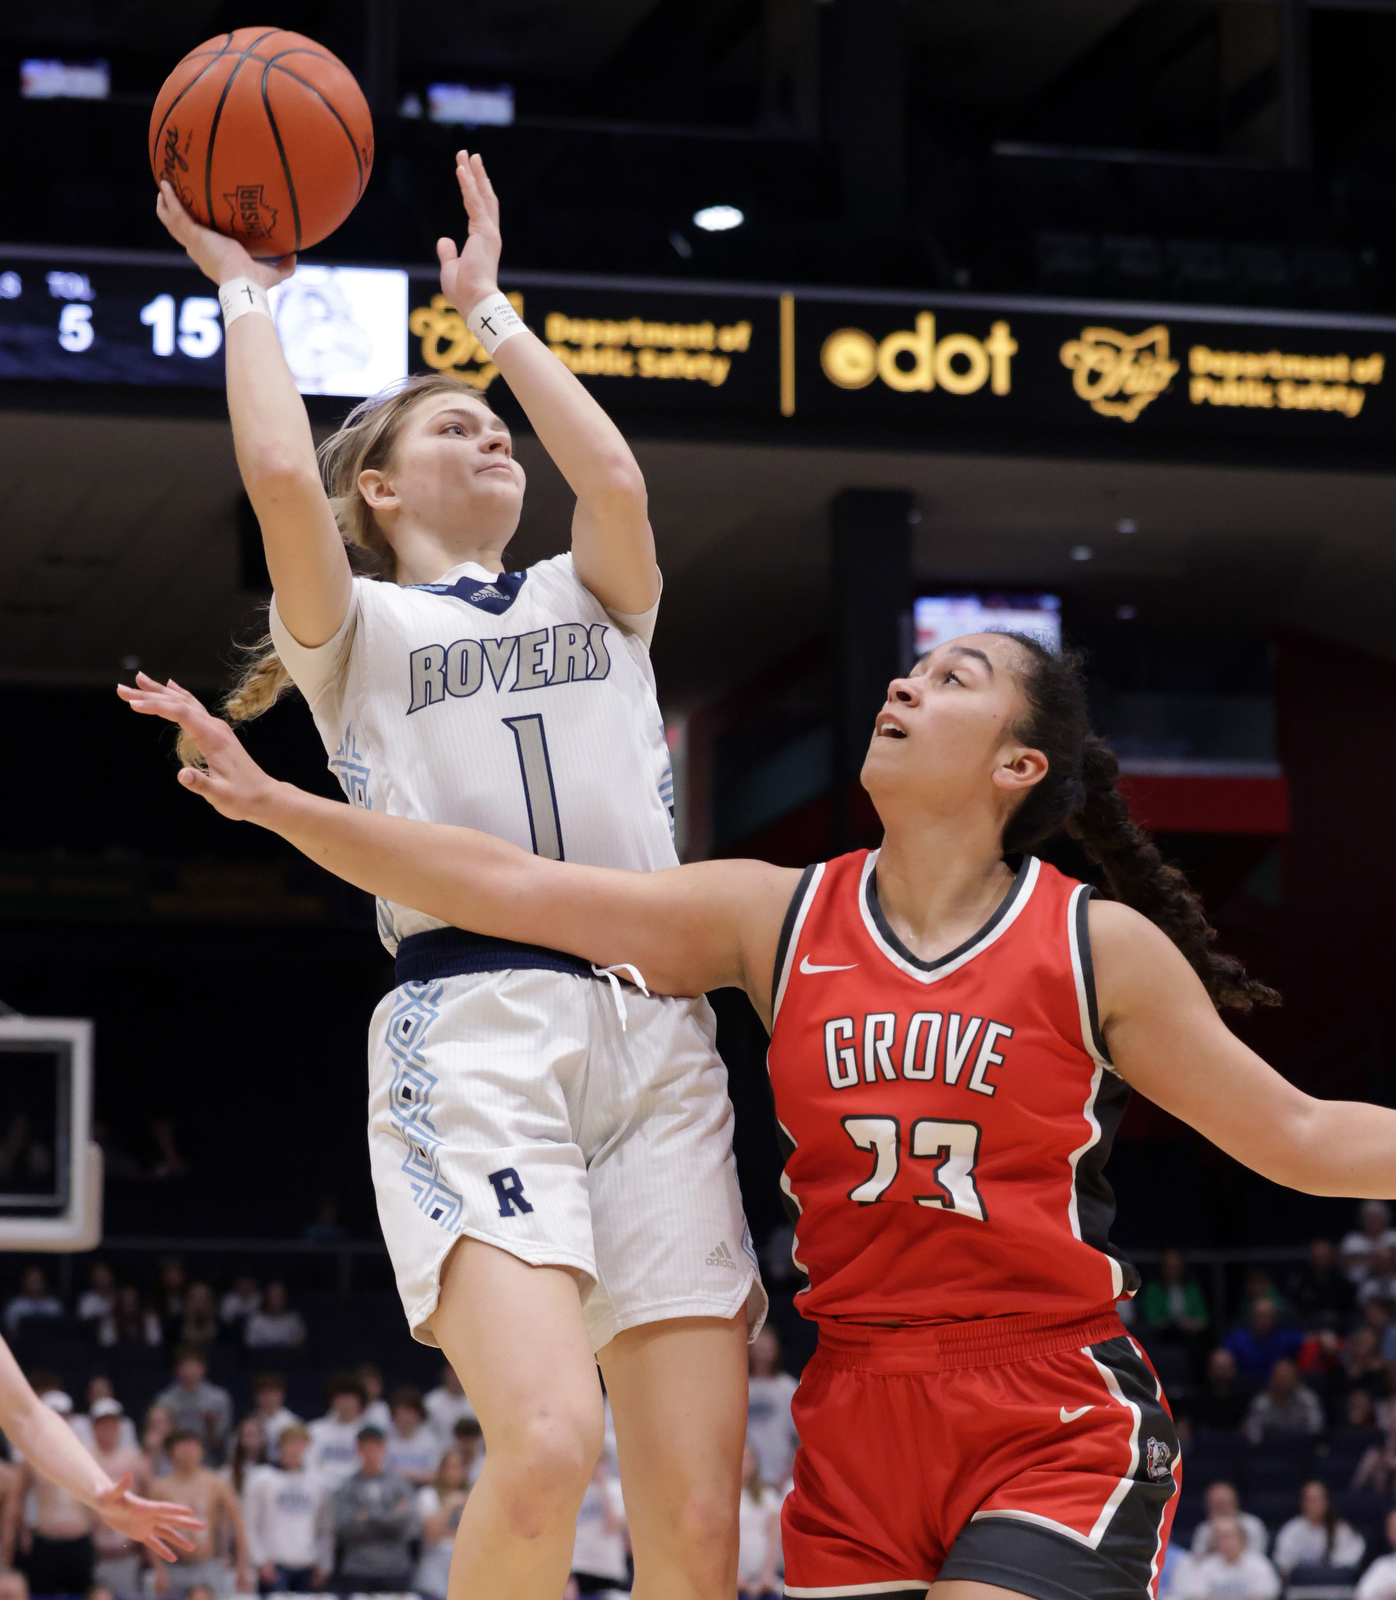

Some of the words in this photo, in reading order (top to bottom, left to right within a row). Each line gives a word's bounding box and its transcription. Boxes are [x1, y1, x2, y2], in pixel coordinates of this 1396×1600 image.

[59, 304, 94, 352] 5
[140, 293, 222, 358] 15
[545, 311, 715, 350] Department
[717, 321, 752, 353] of
[636, 348, 731, 387] Safety
[1189, 345, 1350, 383] Department
[1351, 353, 1385, 385] of
[1189, 376, 1274, 409] Public
[1276, 379, 1366, 418] Safety
[470, 591, 511, 602] adidas
[406, 622, 612, 716] ROVERS
[501, 713, 565, 863] 1
[823, 1011, 1015, 1098] GROVE
[840, 1114, 989, 1222] 23
[488, 1167, 534, 1218] R
[705, 1256, 737, 1270] adidas
